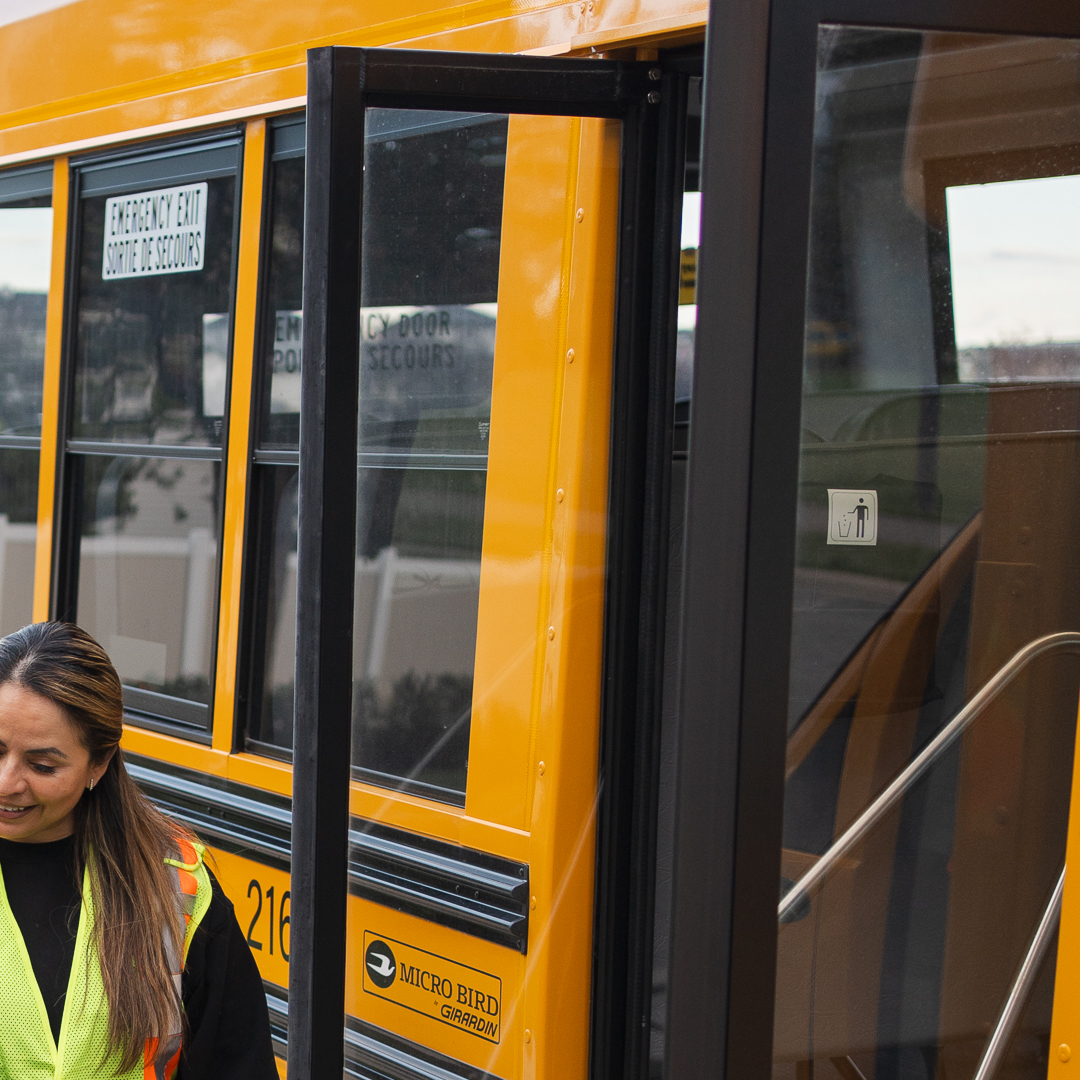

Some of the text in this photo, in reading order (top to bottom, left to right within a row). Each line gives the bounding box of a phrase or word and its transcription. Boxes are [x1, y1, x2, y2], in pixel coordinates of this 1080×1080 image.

[111, 189, 201, 236] EMERGENCY EXIT
[106, 230, 201, 275] SORTIE DE SECOURS
[399, 311, 451, 337] DOOR
[369, 344, 455, 370] SECOURS
[399, 962, 499, 1017] MICRO BIRD
[440, 1004, 498, 1037] GIRARDIN
